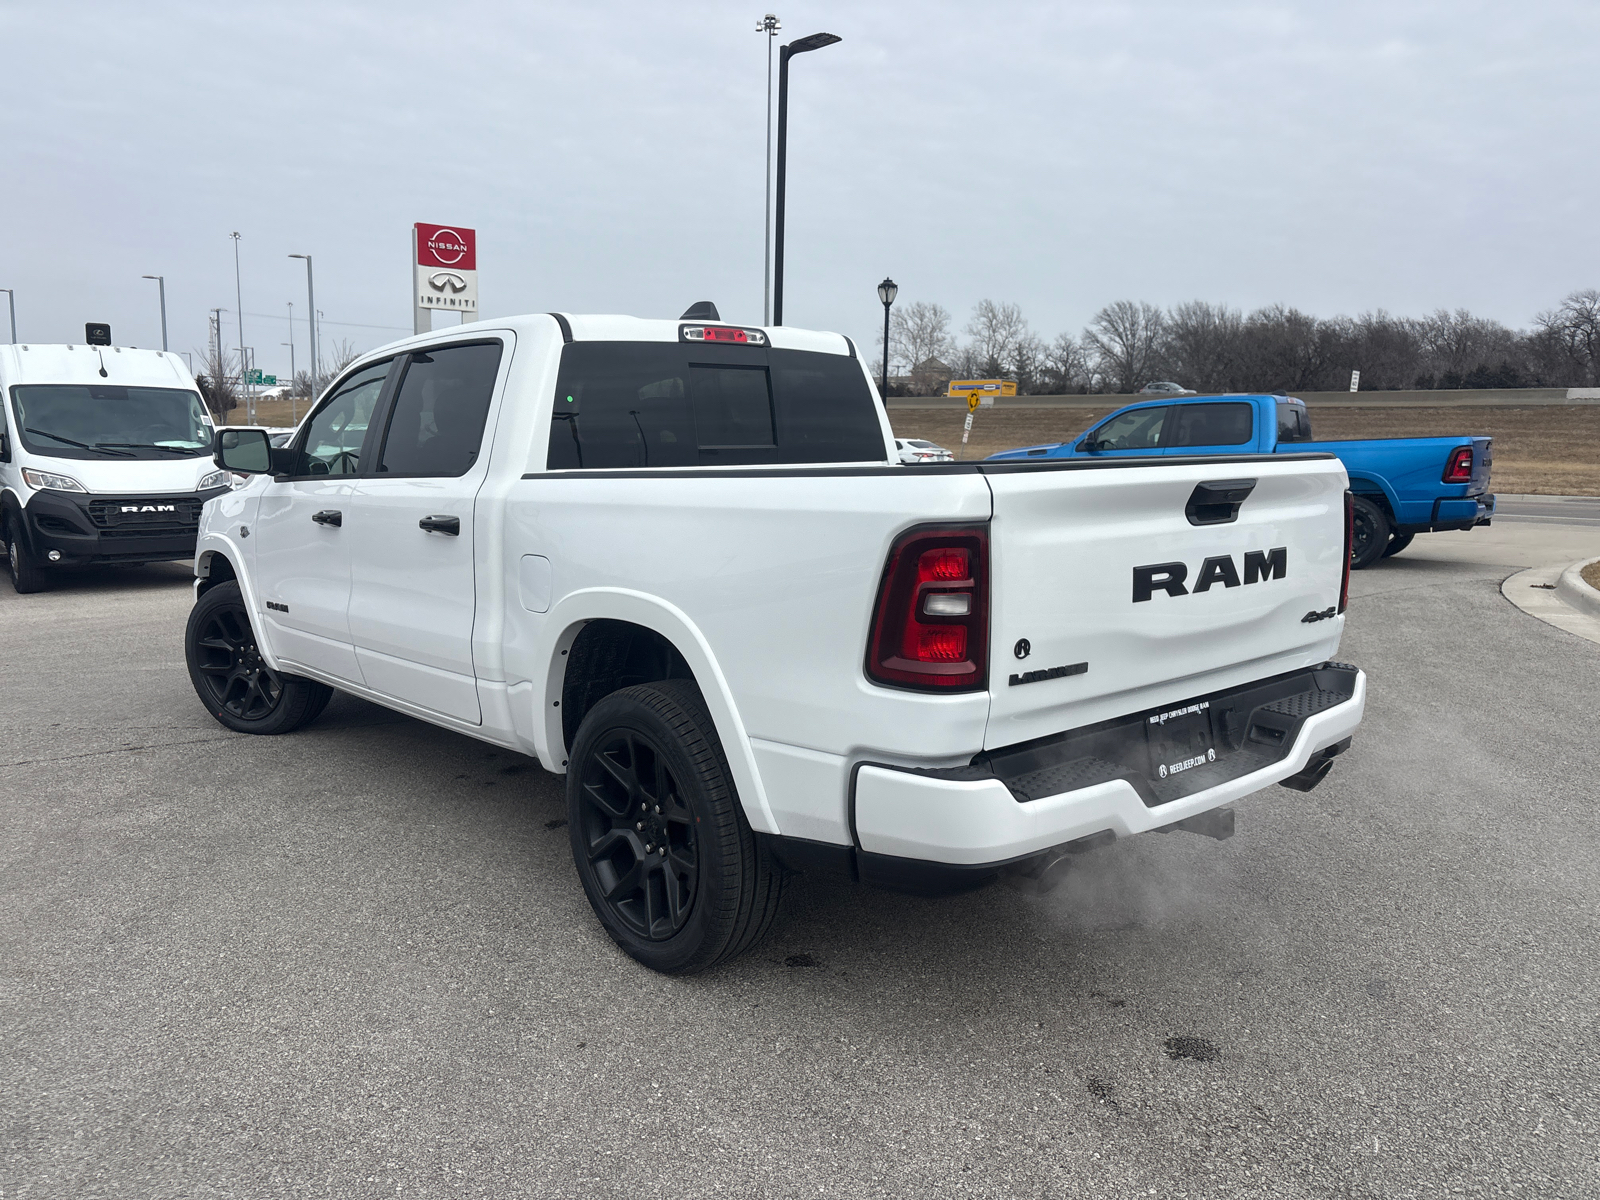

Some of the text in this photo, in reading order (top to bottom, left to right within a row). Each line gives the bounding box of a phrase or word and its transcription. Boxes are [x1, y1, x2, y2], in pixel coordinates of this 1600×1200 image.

[428, 242, 467, 252] NISSAN
[421, 296, 475, 308] INFINITI
[121, 505, 175, 513] RAM
[1132, 546, 1287, 603] RAM
[1160, 713, 1168, 721] JEEP
[1169, 708, 1187, 718] CHRYSLER
[1188, 704, 1199, 713] DODGE
[1200, 702, 1209, 710] RAM
